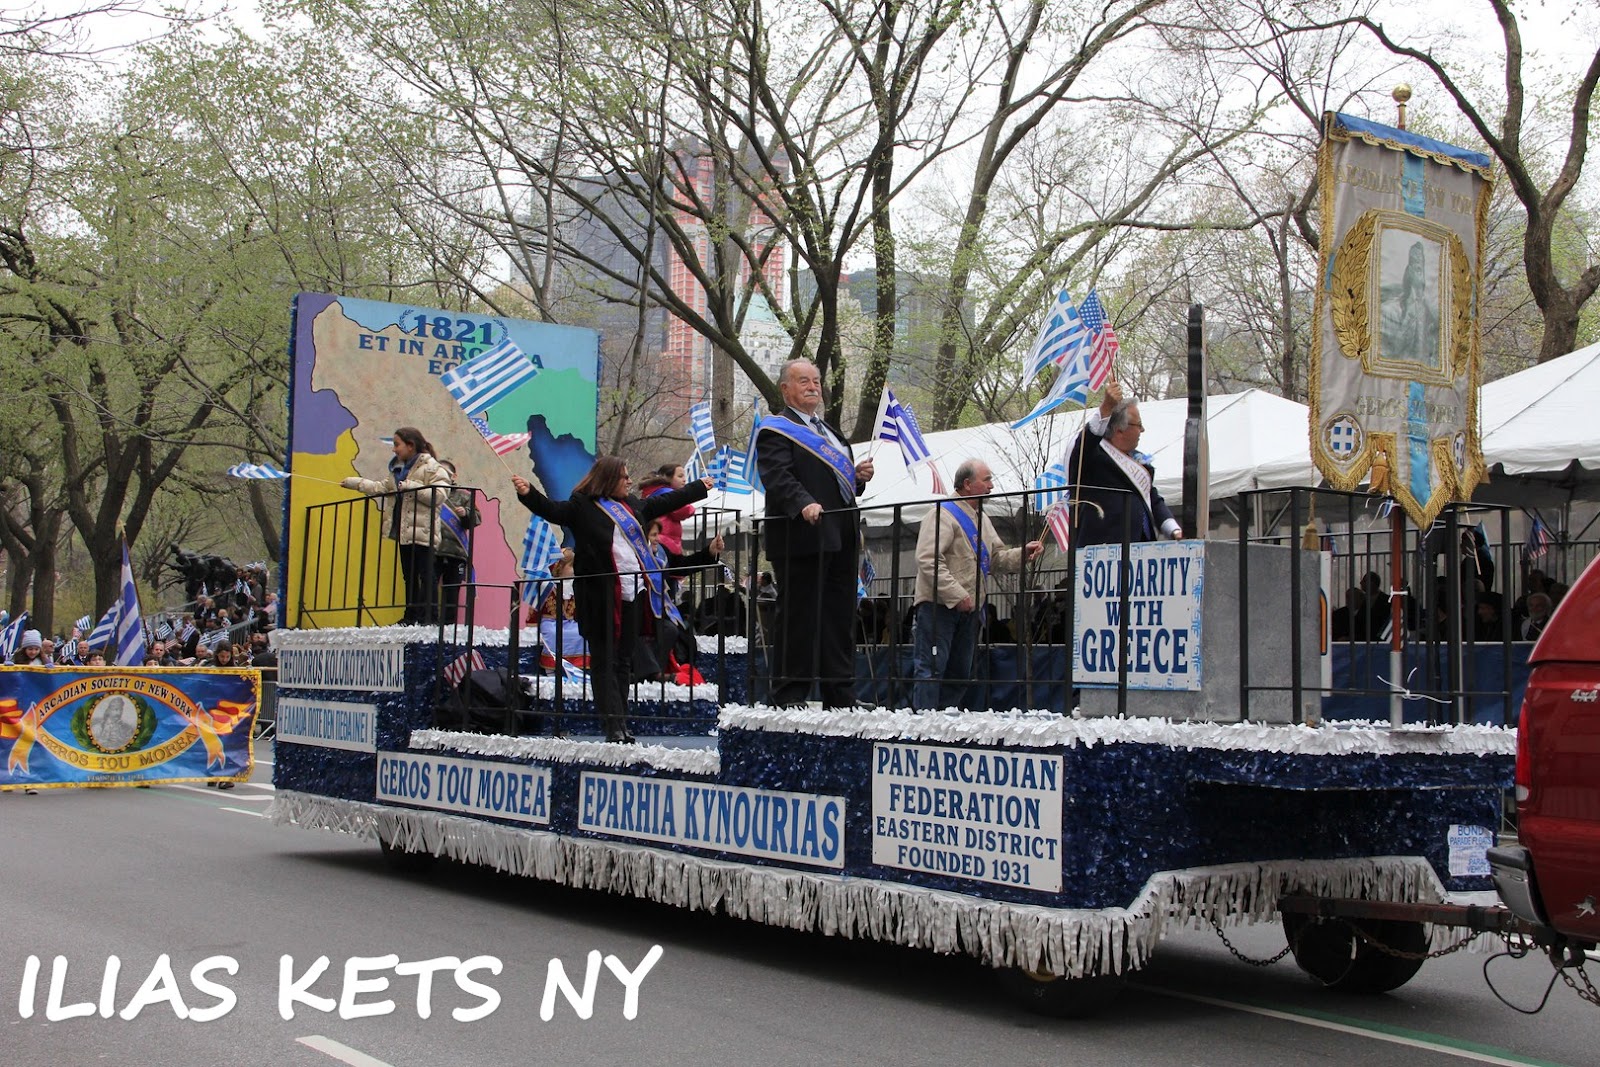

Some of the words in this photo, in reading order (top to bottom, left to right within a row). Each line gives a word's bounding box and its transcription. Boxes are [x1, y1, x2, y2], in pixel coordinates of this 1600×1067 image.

[359, 334, 390, 351] ET
[399, 338, 424, 356] IN
[413, 314, 494, 346] 1821
[1083, 557, 1190, 599] SOLIDARITY
[280, 649, 323, 685] THEODOROS
[324, 649, 385, 687] KOLOKOTRONIS
[1081, 628, 1188, 674] GREECE
[39, 682, 87, 719] ARCADIAN
[91, 677, 131, 691] SOCIETY
[134, 680, 146, 691] OF
[148, 683, 169, 699] NEW
[170, 692, 193, 718] YORK
[40, 733, 89, 767] GEROS
[97, 756, 130, 770] TOU
[138, 731, 198, 767] MOREA
[877, 746, 1057, 792] PAN-ARCADIAN
[379, 757, 431, 800] GEROS
[437, 763, 473, 806] TOU
[476, 769, 547, 818] MOREA
[889, 783, 1040, 830] FEDERATION
[582, 776, 676, 838] EPARHIA
[684, 786, 840, 861] KYNOURIAS
[876, 816, 959, 847] EASTERN
[965, 827, 1058, 860] DISTRICT
[1458, 825, 1484, 836] BOND
[1449, 836, 1471, 845] PARADE
[898, 845, 985, 878] FOUNDED
[992, 859, 1031, 886] 1931
